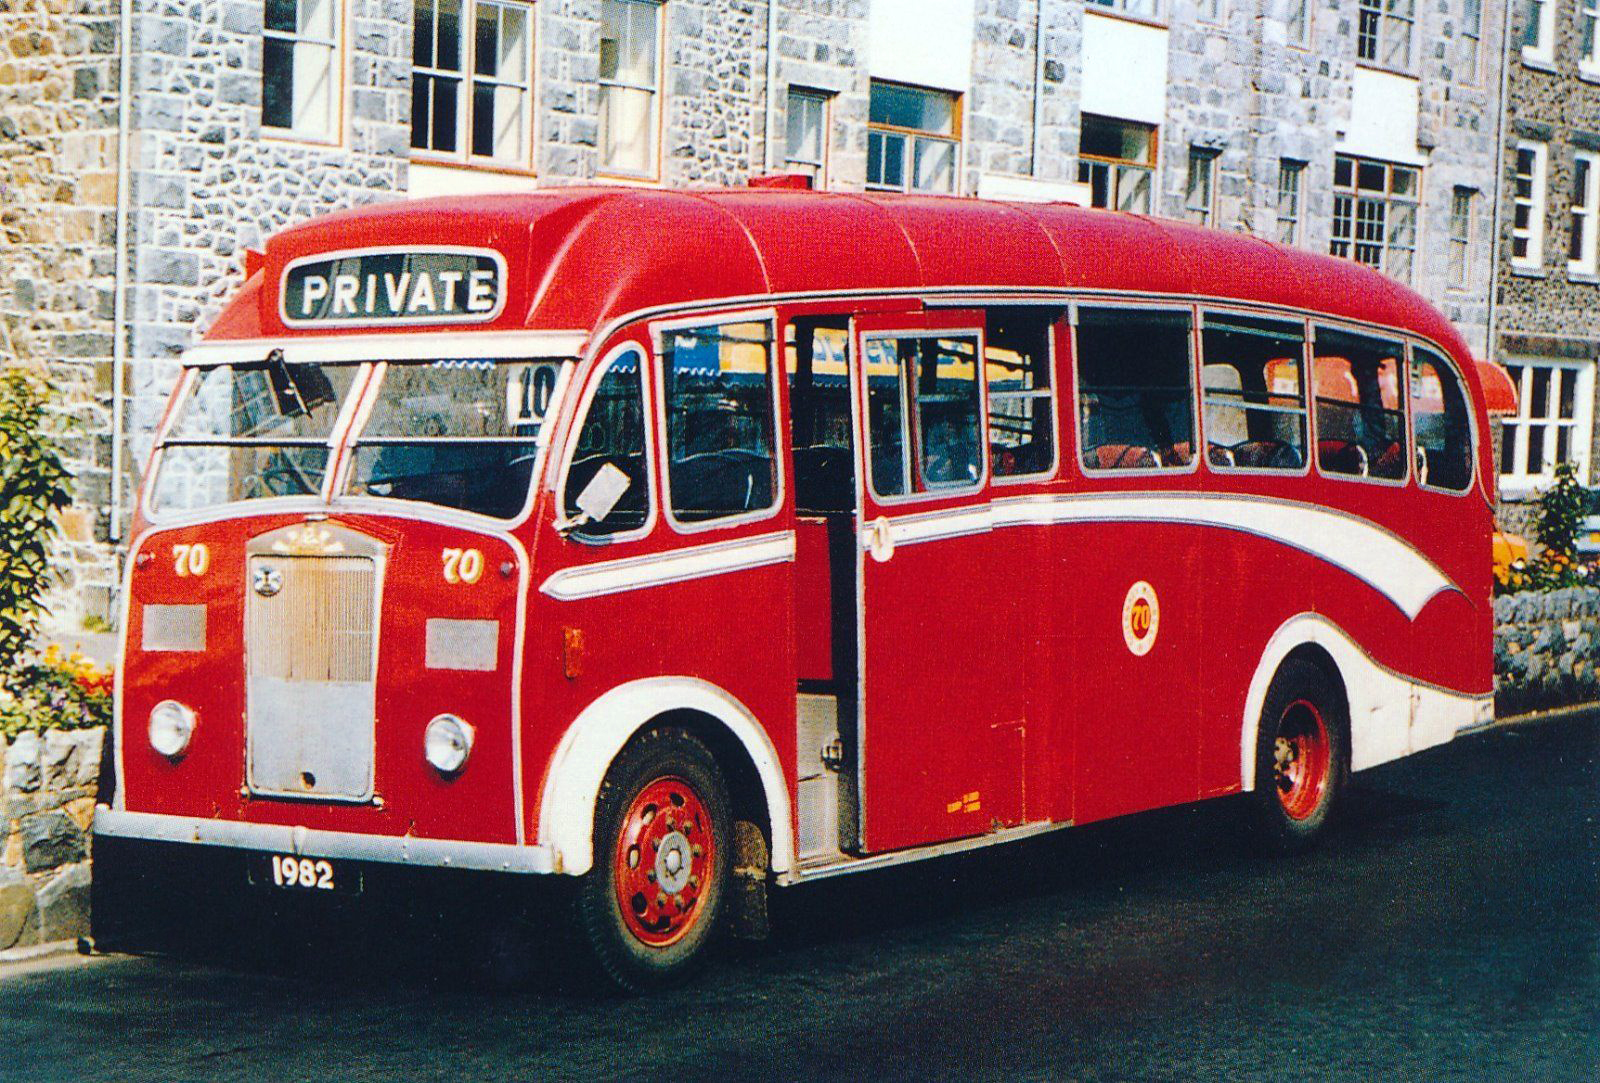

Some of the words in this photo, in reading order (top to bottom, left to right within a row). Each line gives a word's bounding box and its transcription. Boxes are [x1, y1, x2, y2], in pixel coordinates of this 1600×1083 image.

[301, 270, 494, 315] PRIVATE
[172, 543, 209, 576] 70
[442, 547, 484, 584] 70
[1132, 605, 1150, 630] 70
[272, 855, 334, 890] 1982
